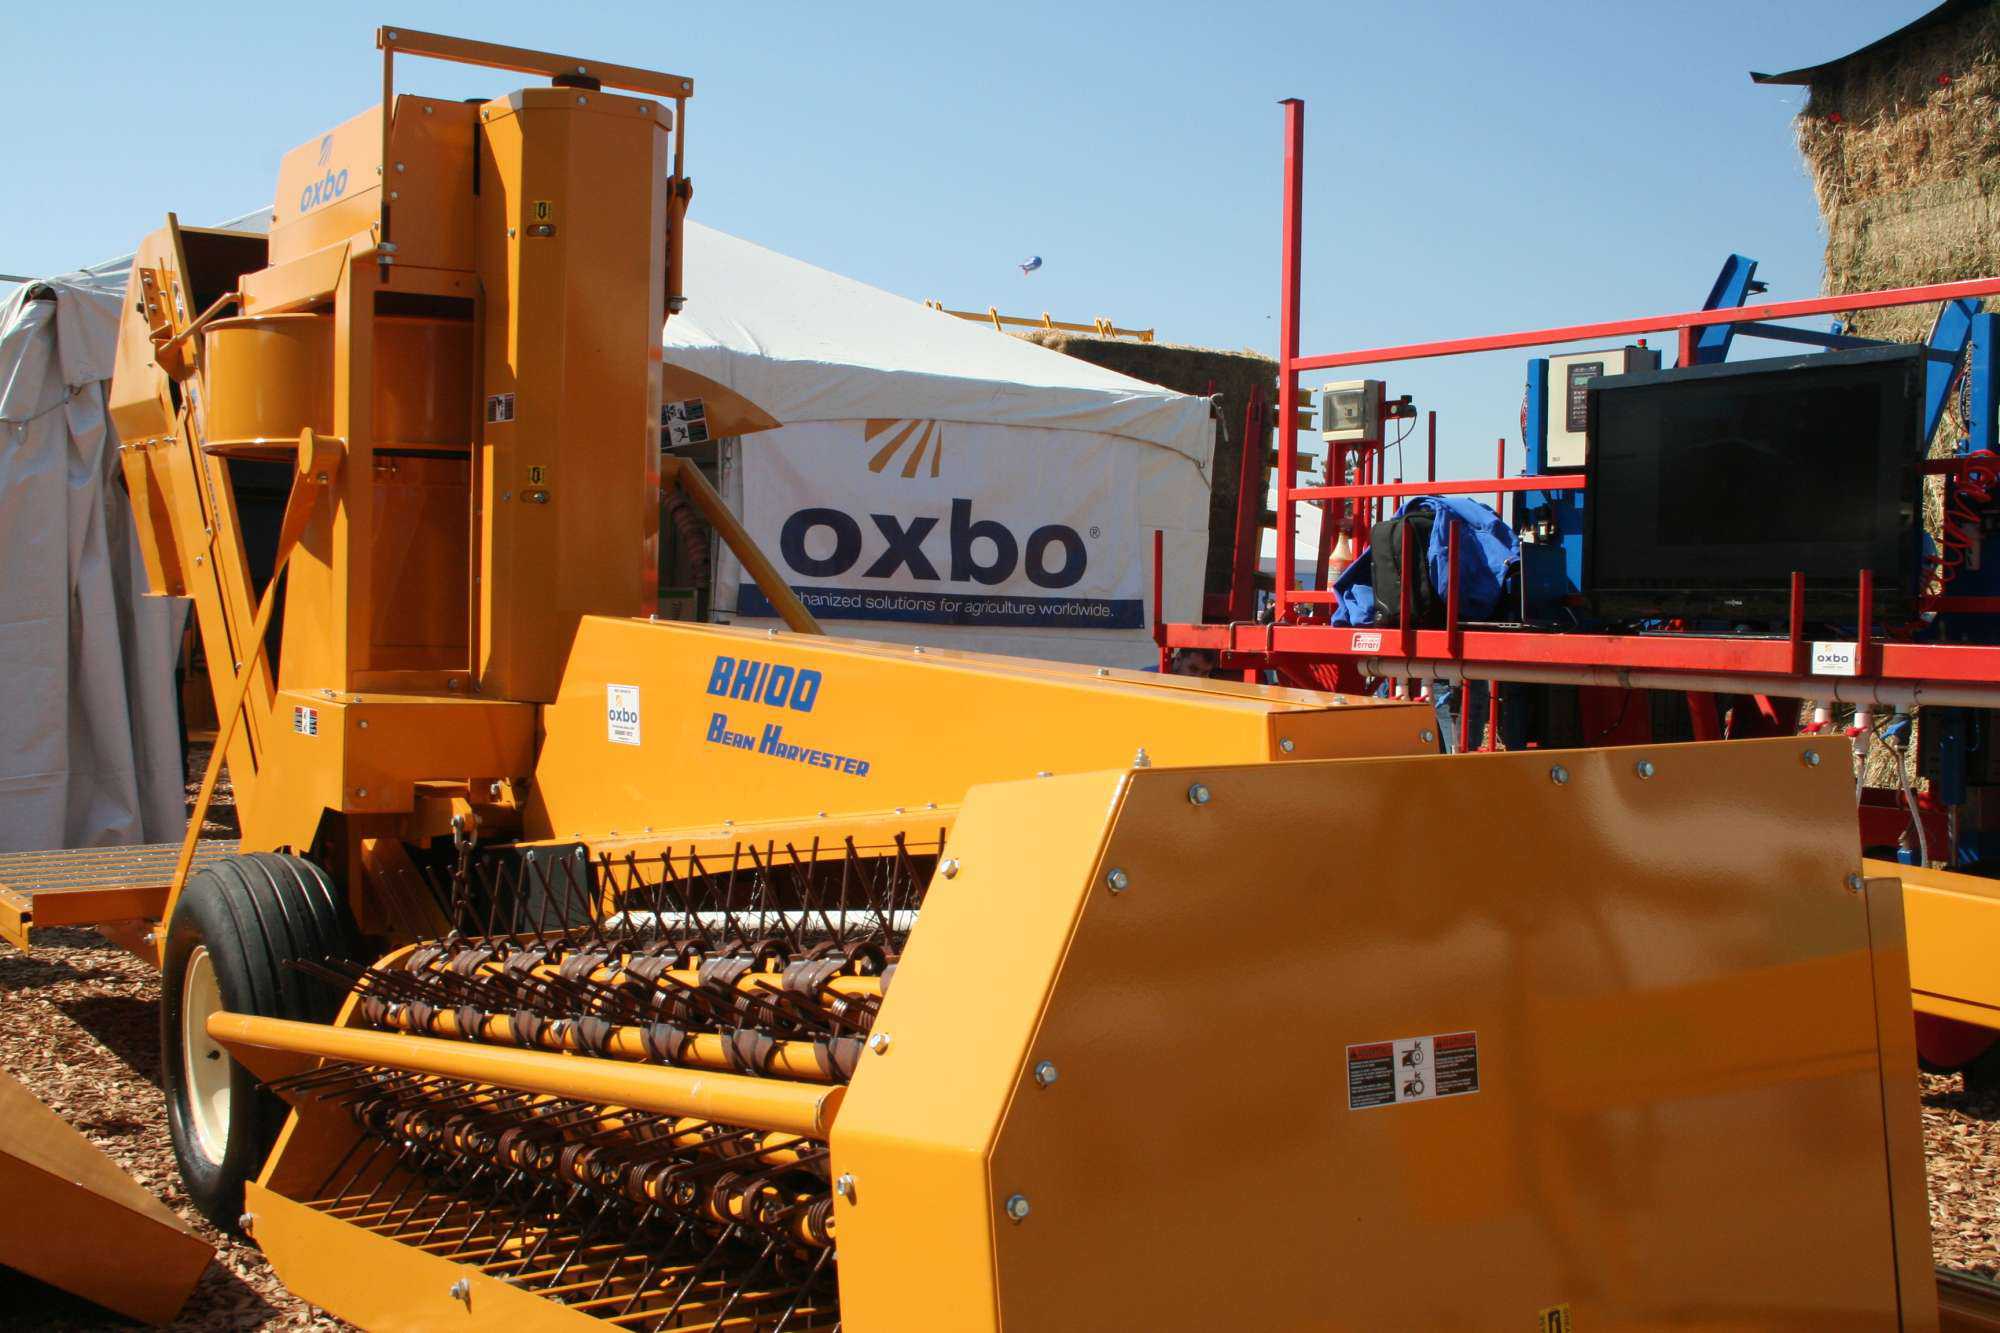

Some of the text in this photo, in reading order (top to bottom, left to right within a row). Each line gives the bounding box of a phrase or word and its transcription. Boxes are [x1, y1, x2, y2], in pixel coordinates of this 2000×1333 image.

[301, 168, 348, 212] oxbo
[767, 592, 1114, 617] hanized solutions for agriculture worldwide.
[1817, 653, 1849, 663] oxbo
[609, 707, 638, 724] oxbo
[706, 712, 870, 777] BEAN HARVESTER
